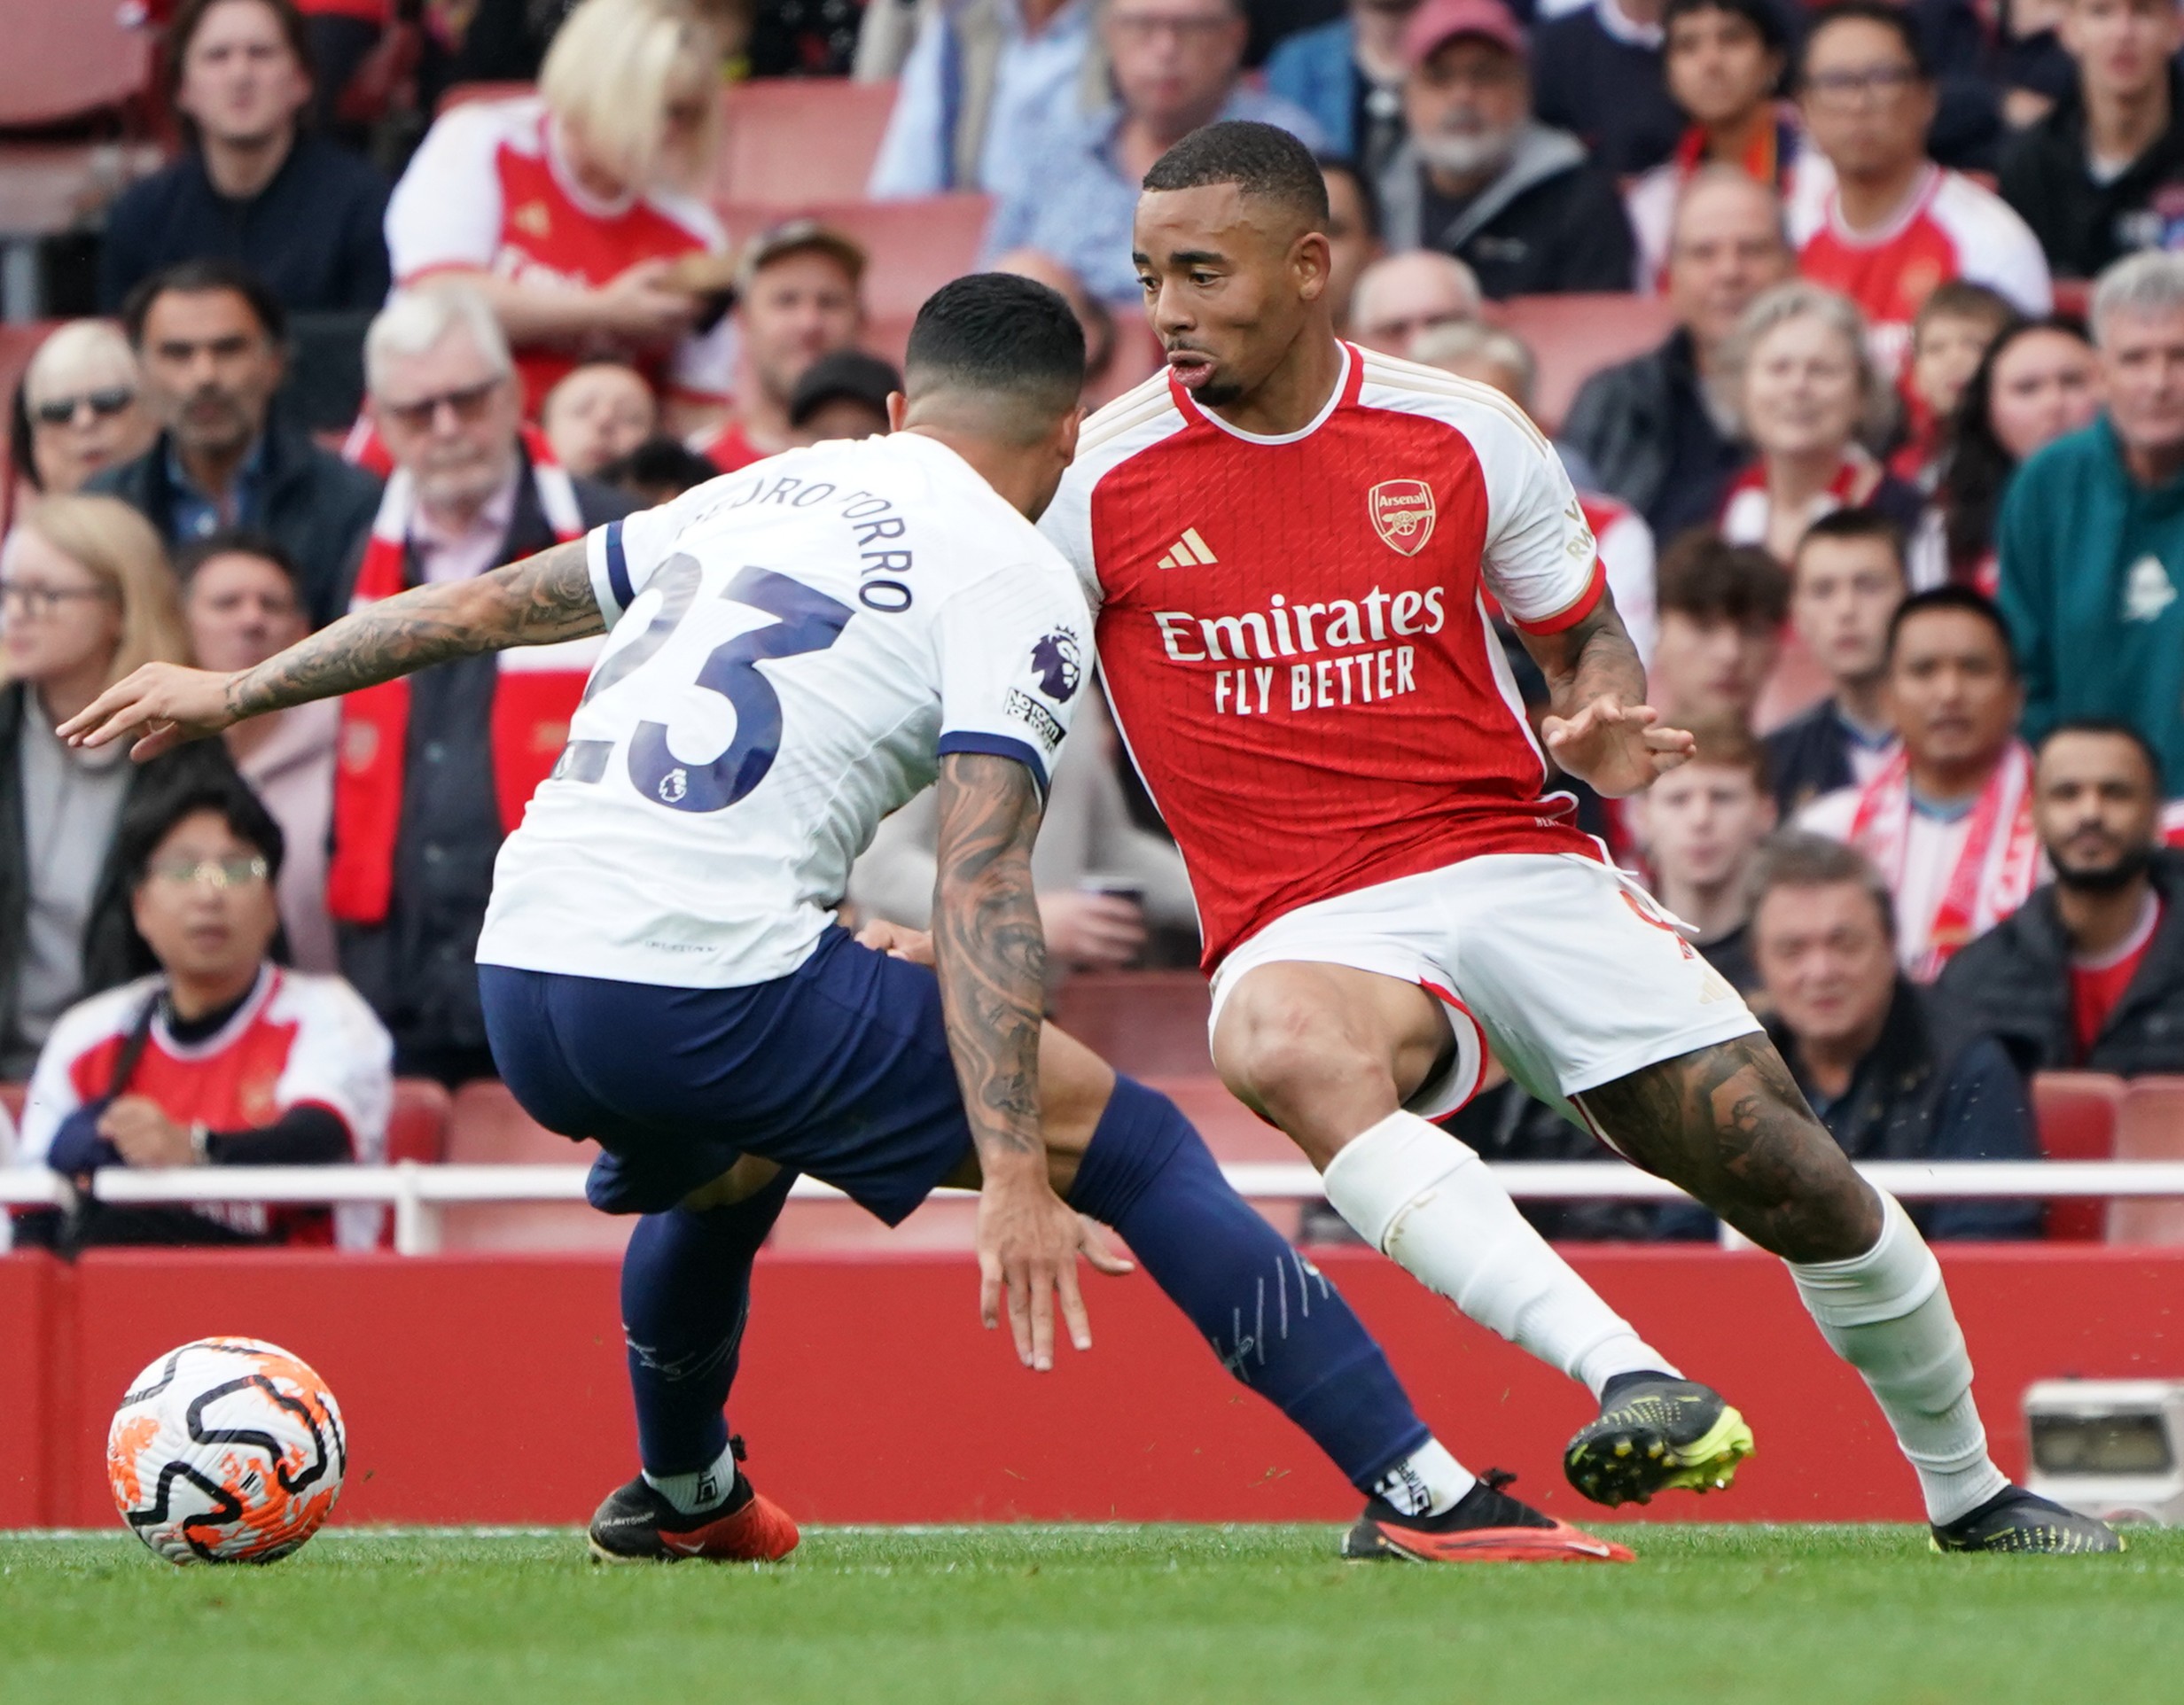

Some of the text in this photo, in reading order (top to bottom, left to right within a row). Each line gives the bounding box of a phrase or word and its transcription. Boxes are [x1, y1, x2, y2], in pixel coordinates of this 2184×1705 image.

[1379, 492, 1425, 508] Arsenal
[1153, 585, 1445, 661] Emirates
[550, 551, 856, 813] 23
[1215, 645, 1416, 715] FLY BETTER
